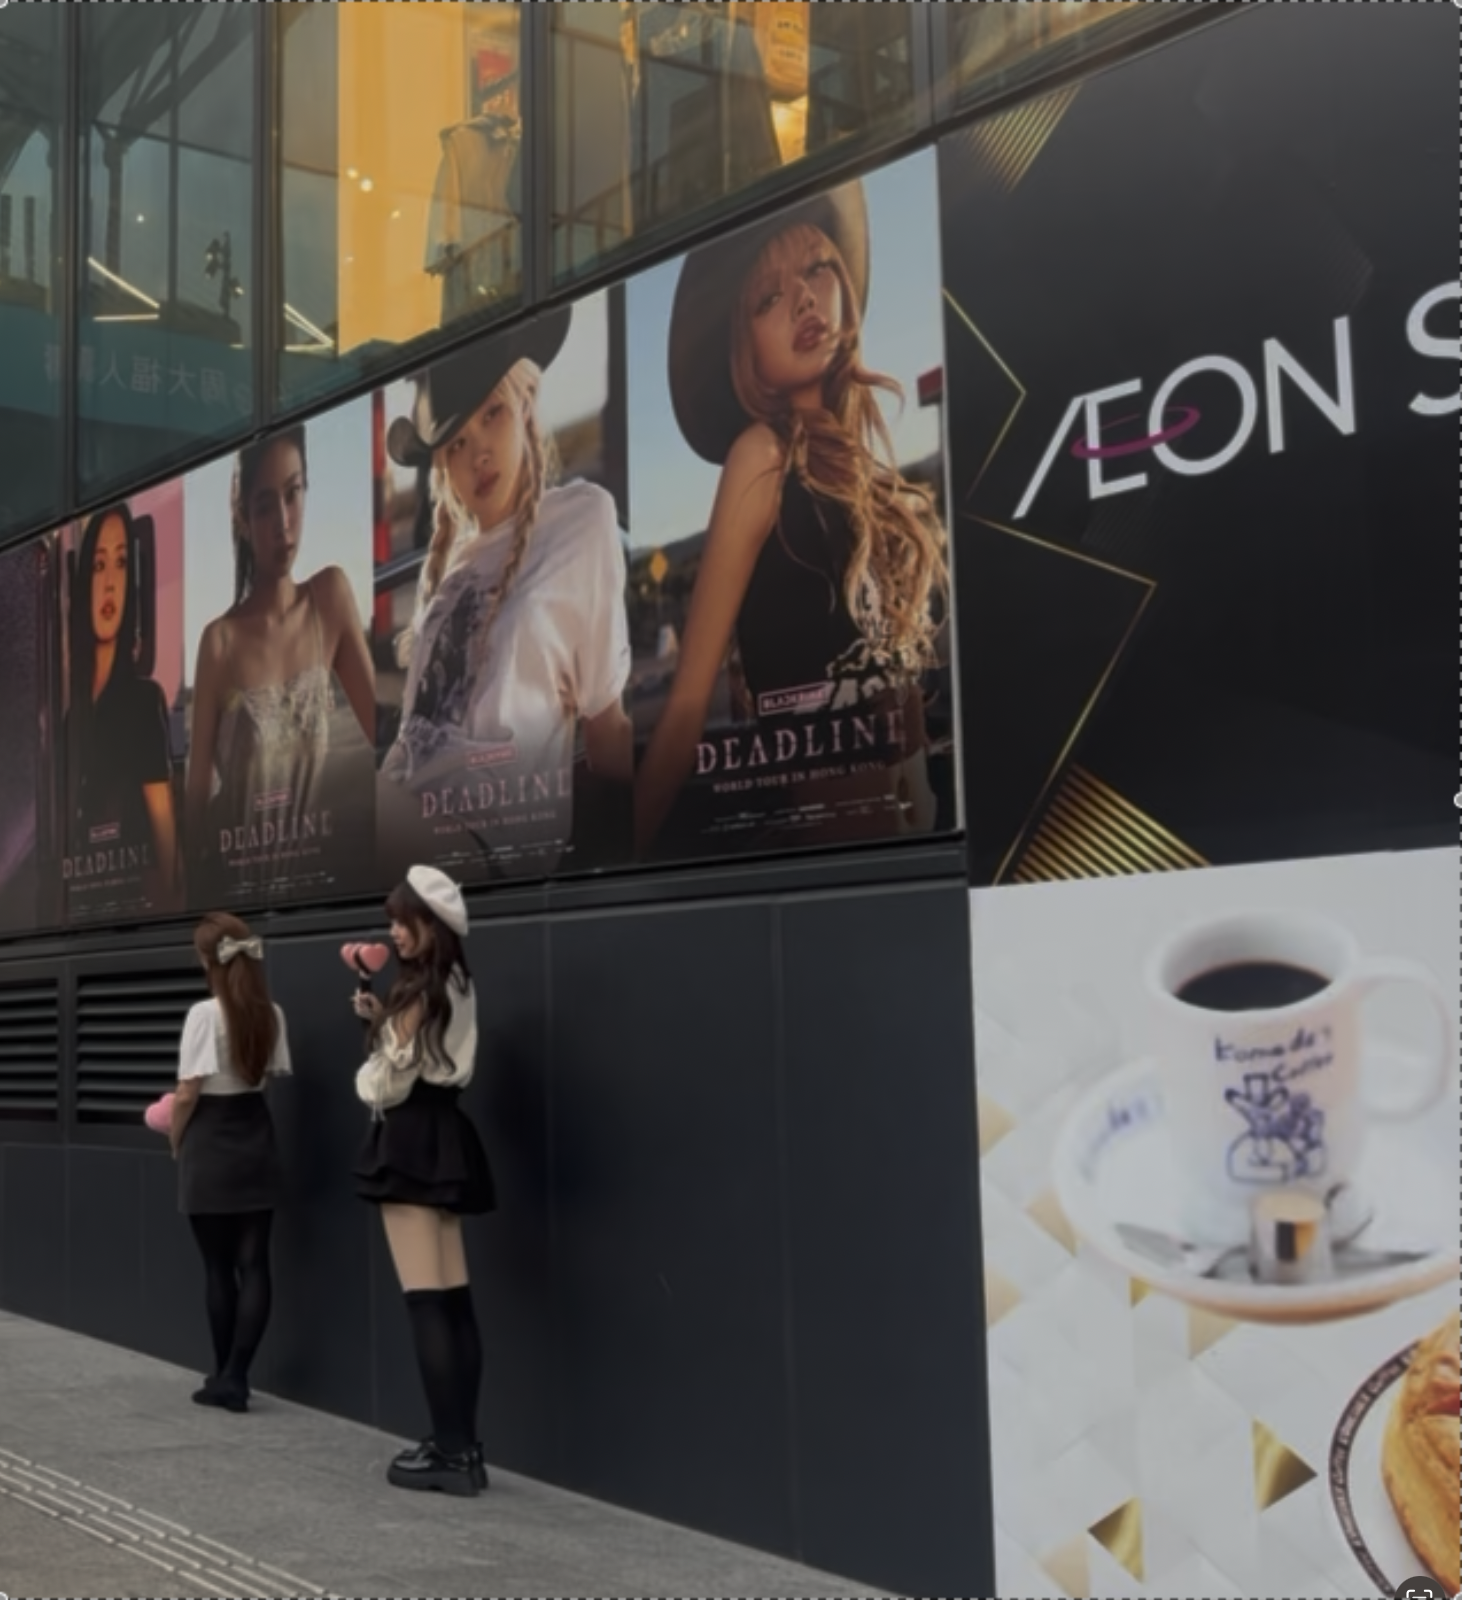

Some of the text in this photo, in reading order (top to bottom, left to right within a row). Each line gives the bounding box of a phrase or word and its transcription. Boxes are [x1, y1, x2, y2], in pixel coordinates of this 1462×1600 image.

[695, 708, 905, 775] DEADLINE
[421, 767, 571, 820] DEADLINE
[712, 777, 752, 793] WORLD
[791, 770, 806, 784] IN
[219, 809, 333, 853] DEADLINE
